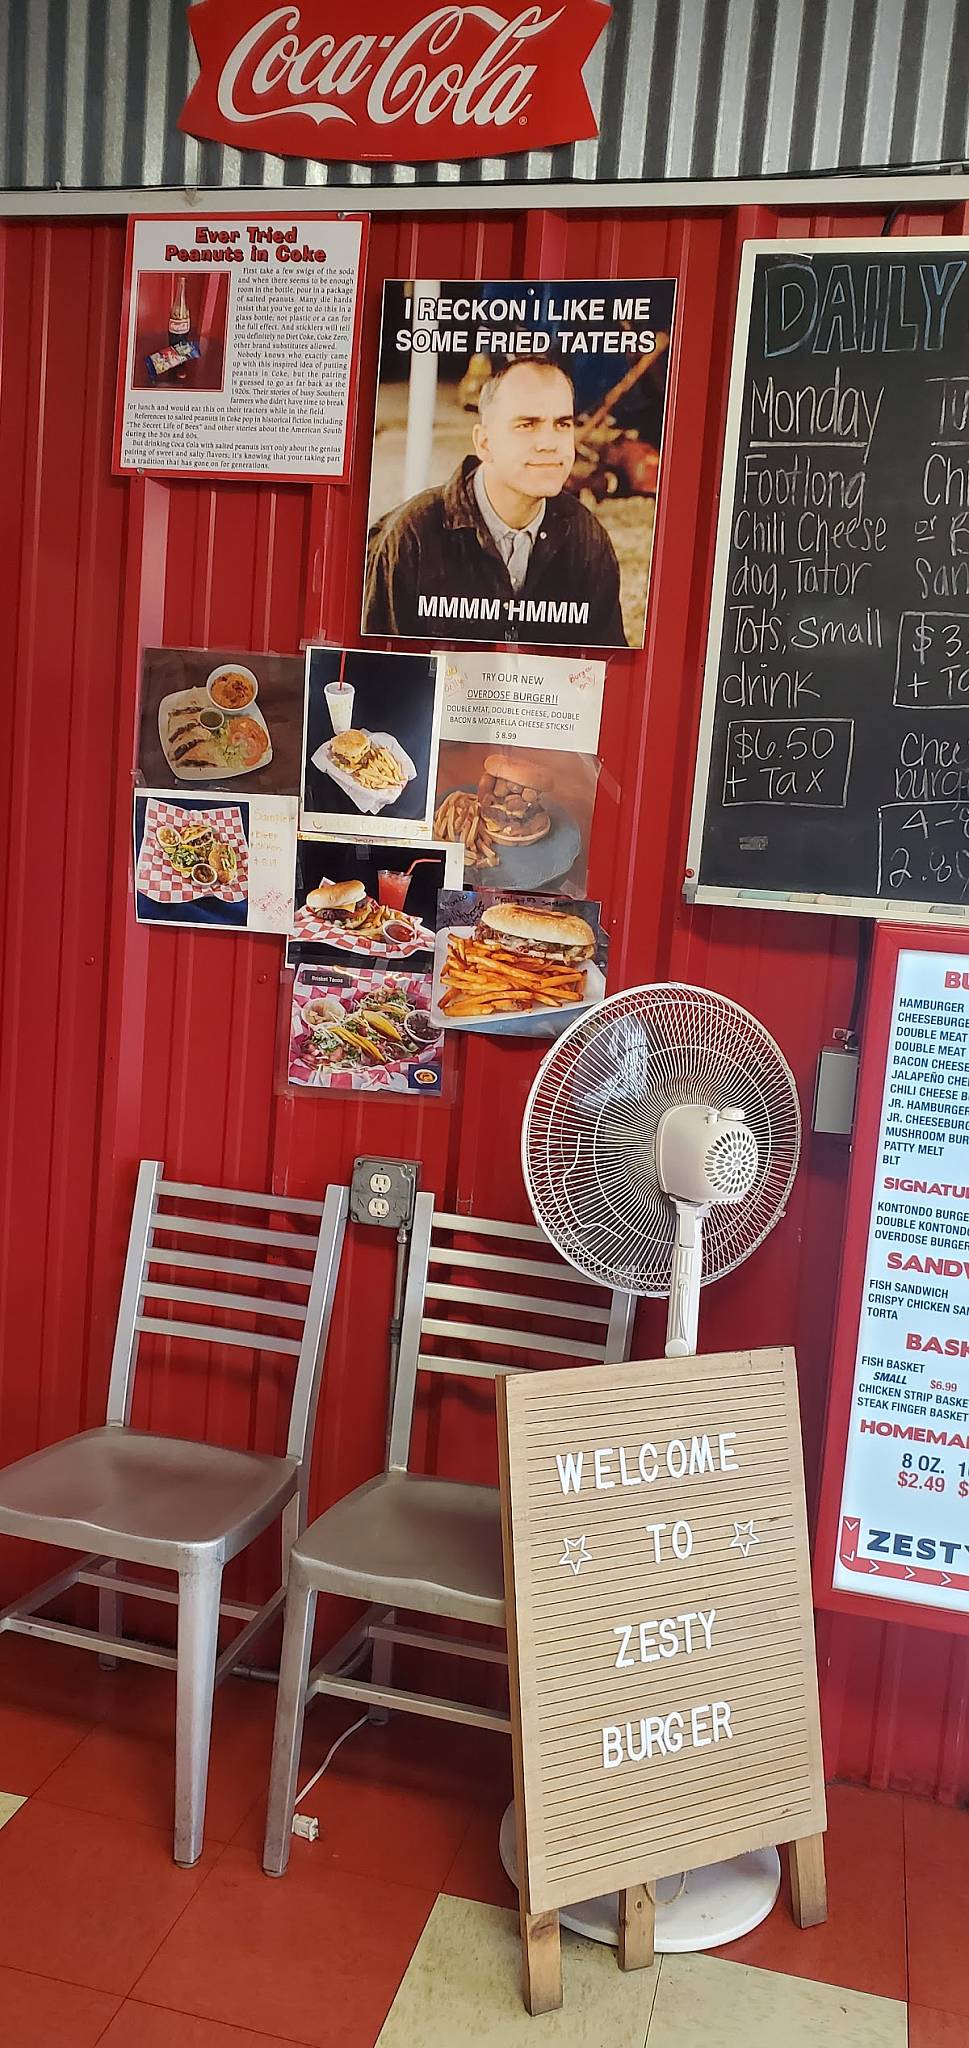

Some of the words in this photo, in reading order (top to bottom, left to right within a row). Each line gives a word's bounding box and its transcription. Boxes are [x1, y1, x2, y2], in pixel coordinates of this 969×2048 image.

[218, 5, 567, 126] Coca-Cola
[195, 226, 240, 244] Ever
[247, 226, 298, 244] Tried
[165, 244, 244, 262] Peanuts
[250, 245, 269, 262] in
[275, 245, 327, 263] Coke
[243, 267, 257, 275] First
[260, 267, 273, 275] take
[283, 267, 293, 275] few
[296, 268, 314, 276] swigs
[317, 267, 325, 275] of
[330, 277, 354, 285] enough
[275, 286, 295, 294] bottle,
[297, 287, 311, 295] pour
[326, 287, 353, 295] package
[404, 298, 411, 320] I
[417, 298, 526, 321] RECKON
[533, 298, 540, 320] I
[547, 298, 605, 321] LIKE
[612, 298, 651, 320] ME
[764, 260, 968, 358] DAILY
[273, 342, 308, 350] substitutes
[395, 329, 468, 353] SOME
[475, 331, 551, 354] FRIED
[558, 331, 656, 354] TATERS
[237, 351, 261, 359] Nobody
[264, 351, 285, 359] knows
[304, 352, 328, 360] exactly
[751, 366, 885, 465] Monday
[743, 453, 866, 528] Footlong
[734, 511, 785, 556] Chili
[798, 511, 887, 554] Cheese
[732, 555, 786, 609] dog,
[789, 557, 872, 596] Tator
[916, 557, 969, 599] San
[418, 595, 500, 621] MMMM
[508, 599, 590, 625] HMMM
[729, 605, 786, 654] Tots,
[791, 608, 882, 648] Small
[482, 673, 496, 681] TRY
[498, 673, 518, 683] OUR
[521, 675, 544, 685] NEW
[722, 661, 820, 708] drink
[467, 689, 511, 700] OVERDOSE
[513, 691, 558, 704] BURGER!!
[447, 705, 471, 713] DOUBLE
[492, 707, 519, 715] DOUBLE
[551, 711, 580, 720] DOUBLE
[450, 716, 471, 724] BACON
[478, 718, 516, 727] MOZARELLA
[518, 720, 545, 729] CHEESE
[735, 727, 835, 764] $6.50
[759, 767, 824, 799] Tax
[899, 998, 965, 1013] HAMBURGER
[896, 1026, 937, 1040] DOUBLE
[939, 1030, 968, 1043] MEAT
[894, 1041, 936, 1055] DOUBLE
[937, 1045, 967, 1058] MEAT
[893, 1055, 928, 1068] BACON
[891, 1069, 944, 1085] JALAPEÑO
[947, 1075, 969, 1087] CHE
[890, 1083, 916, 1096] CHILI
[919, 1086, 958, 1100] CHEESE
[888, 1098, 904, 1110] JR.
[886, 1112, 903, 1124] JR.
[885, 1126, 945, 1143] MUSHROOM
[948, 1133, 969, 1146] BUR
[883, 1140, 916, 1153] PATTY
[918, 1144, 944, 1157] MELT
[882, 1154, 901, 1166] BLT
[877, 1201, 932, 1218] KONTONDO
[935, 1208, 969, 1222] BURGE
[876, 1215, 916, 1230] DOUBLE
[874, 1229, 928, 1246] OVERDOSE
[887, 1251, 969, 1280] SAND
[869, 1279, 892, 1292] FISH
[894, 1282, 949, 1299] SANDWICH
[866, 1306, 898, 1320] TORTA
[868, 1293, 904, 1307] CRISPY
[906, 1299, 950, 1314] CHICKEN
[861, 1355, 885, 1369] FISH
[886, 1358, 925, 1374] BASKET
[873, 1371, 907, 1385] SMALL
[930, 1379, 957, 1392] $6.99
[858, 1383, 901, 1398] CHICKEN
[904, 1389, 933, 1402] STRIP
[936, 1394, 969, 1408] BASKE
[857, 1397, 889, 1411] STEAK
[891, 1401, 927, 1415] FINGER
[930, 1407, 969, 1422] BASKET
[860, 1419, 969, 1449] HOMEMA
[555, 1432, 739, 1495] WELCOME
[902, 1453, 913, 1468] 8
[918, 1455, 945, 1474] OZ.
[897, 1470, 945, 1493] $2.49
[646, 1520, 693, 1564] TO
[867, 1529, 969, 1565] ZEST
[613, 1609, 716, 1668] ZESTY
[602, 1701, 733, 1768] BURGER
